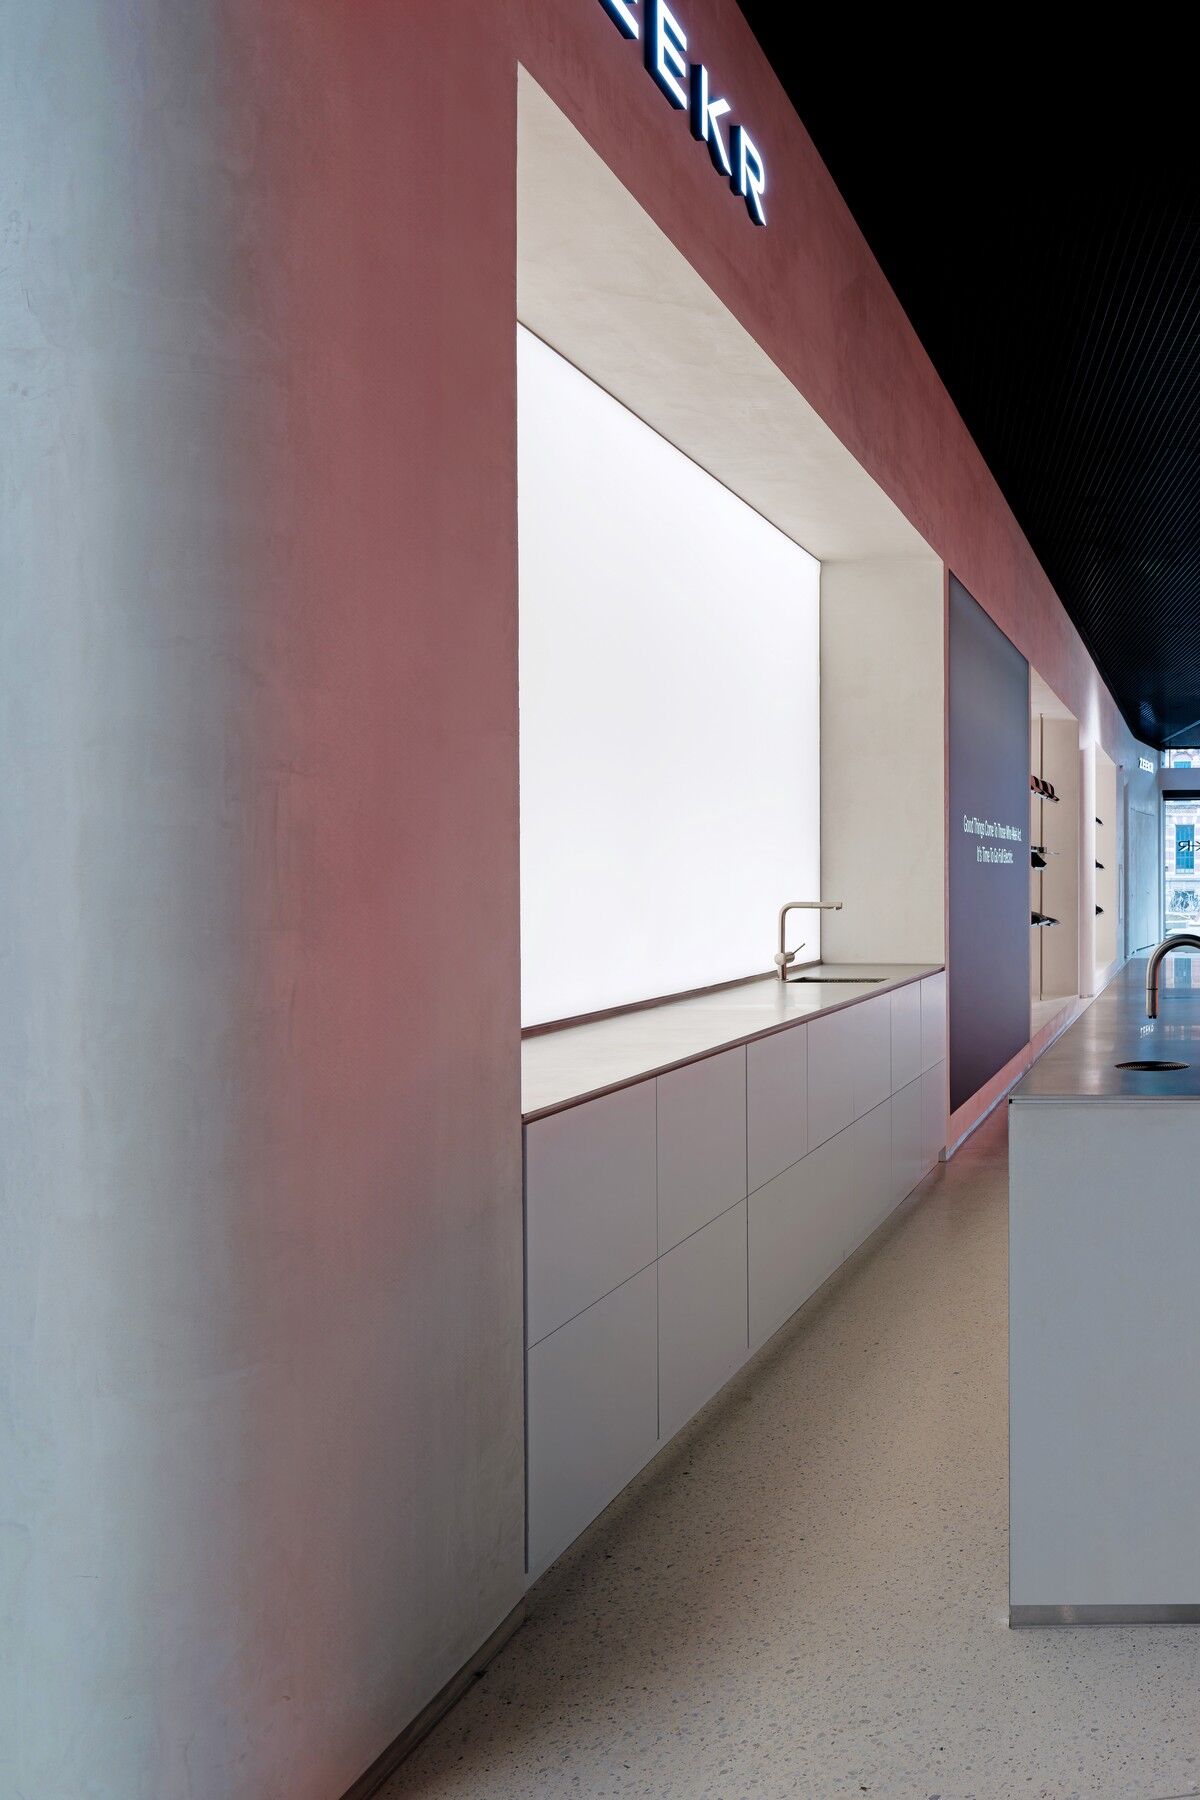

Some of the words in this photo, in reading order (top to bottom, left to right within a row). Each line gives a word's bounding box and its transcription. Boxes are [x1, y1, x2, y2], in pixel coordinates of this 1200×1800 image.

[964, 815, 973, 833] Good
[974, 817, 984, 839] Things
[985, 820, 994, 837] Come
